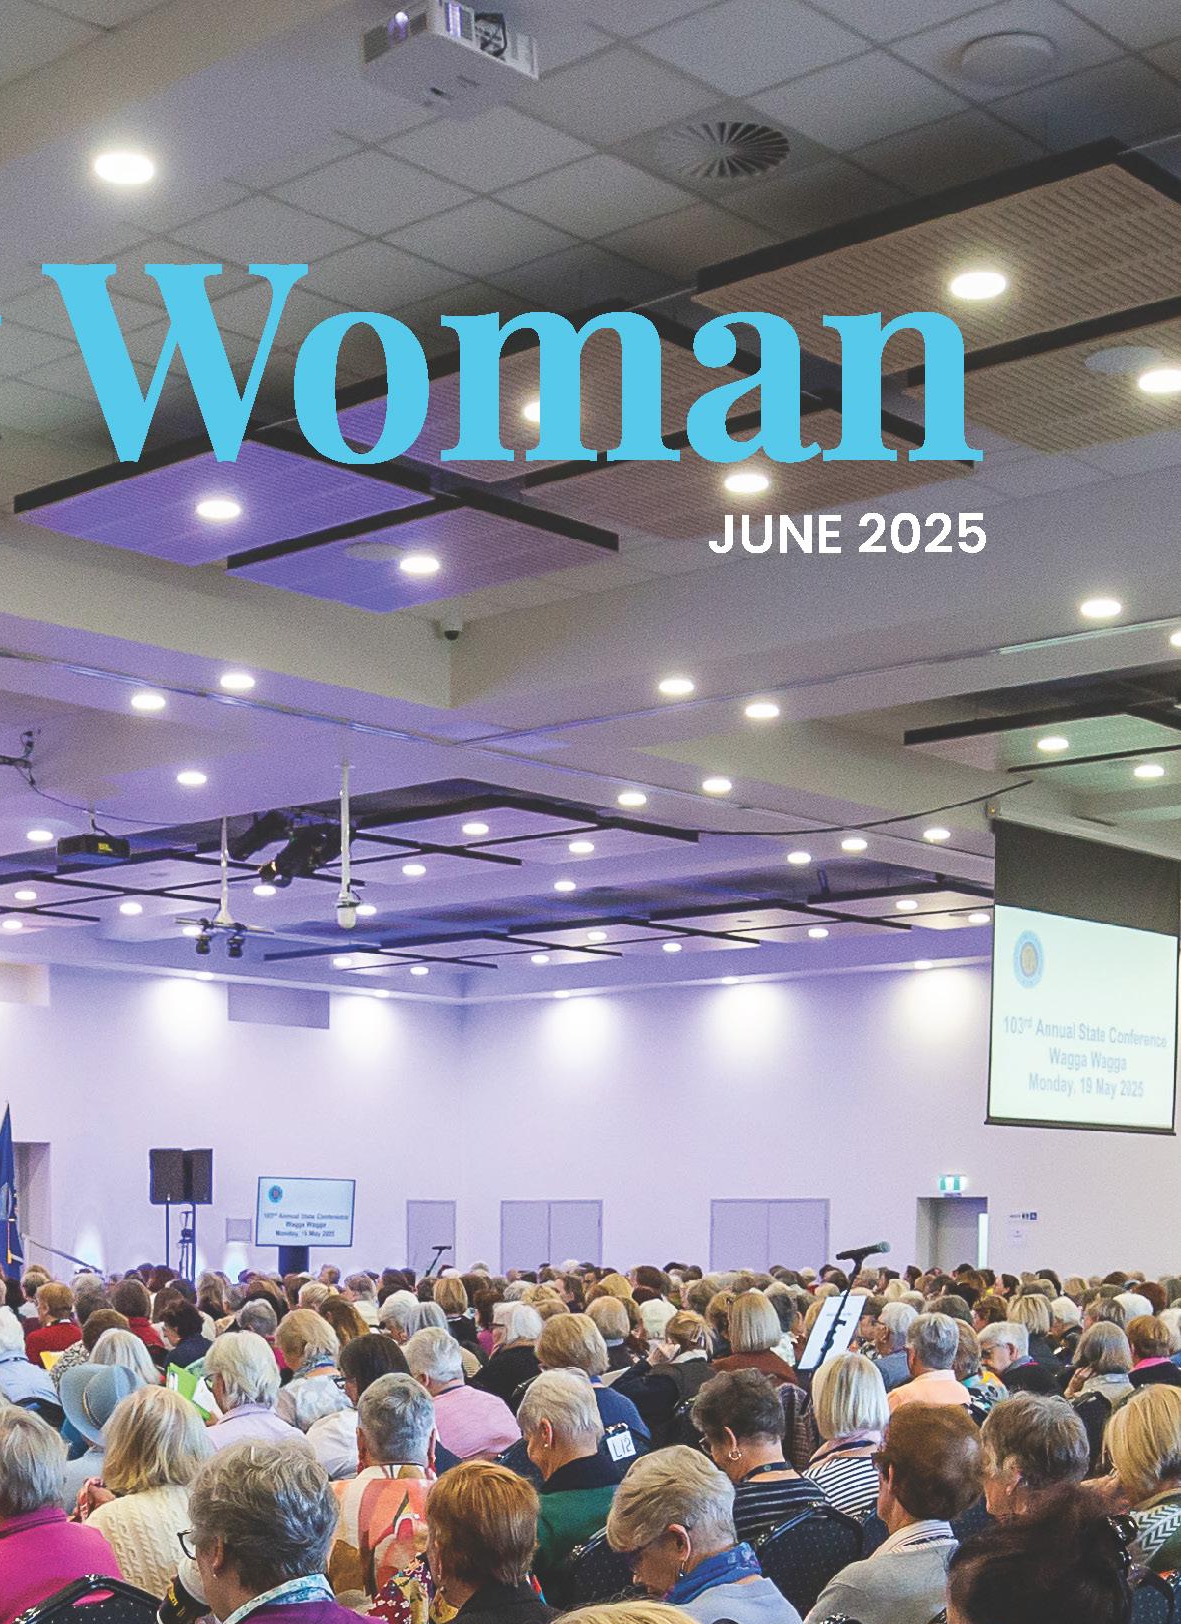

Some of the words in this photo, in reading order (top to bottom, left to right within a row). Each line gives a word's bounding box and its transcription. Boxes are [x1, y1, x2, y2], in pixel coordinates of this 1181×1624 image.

[1035, 1019, 1076, 1040] Annual
[1078, 1022, 1105, 1043] State
[1049, 1046, 1087, 1071] Wagga
